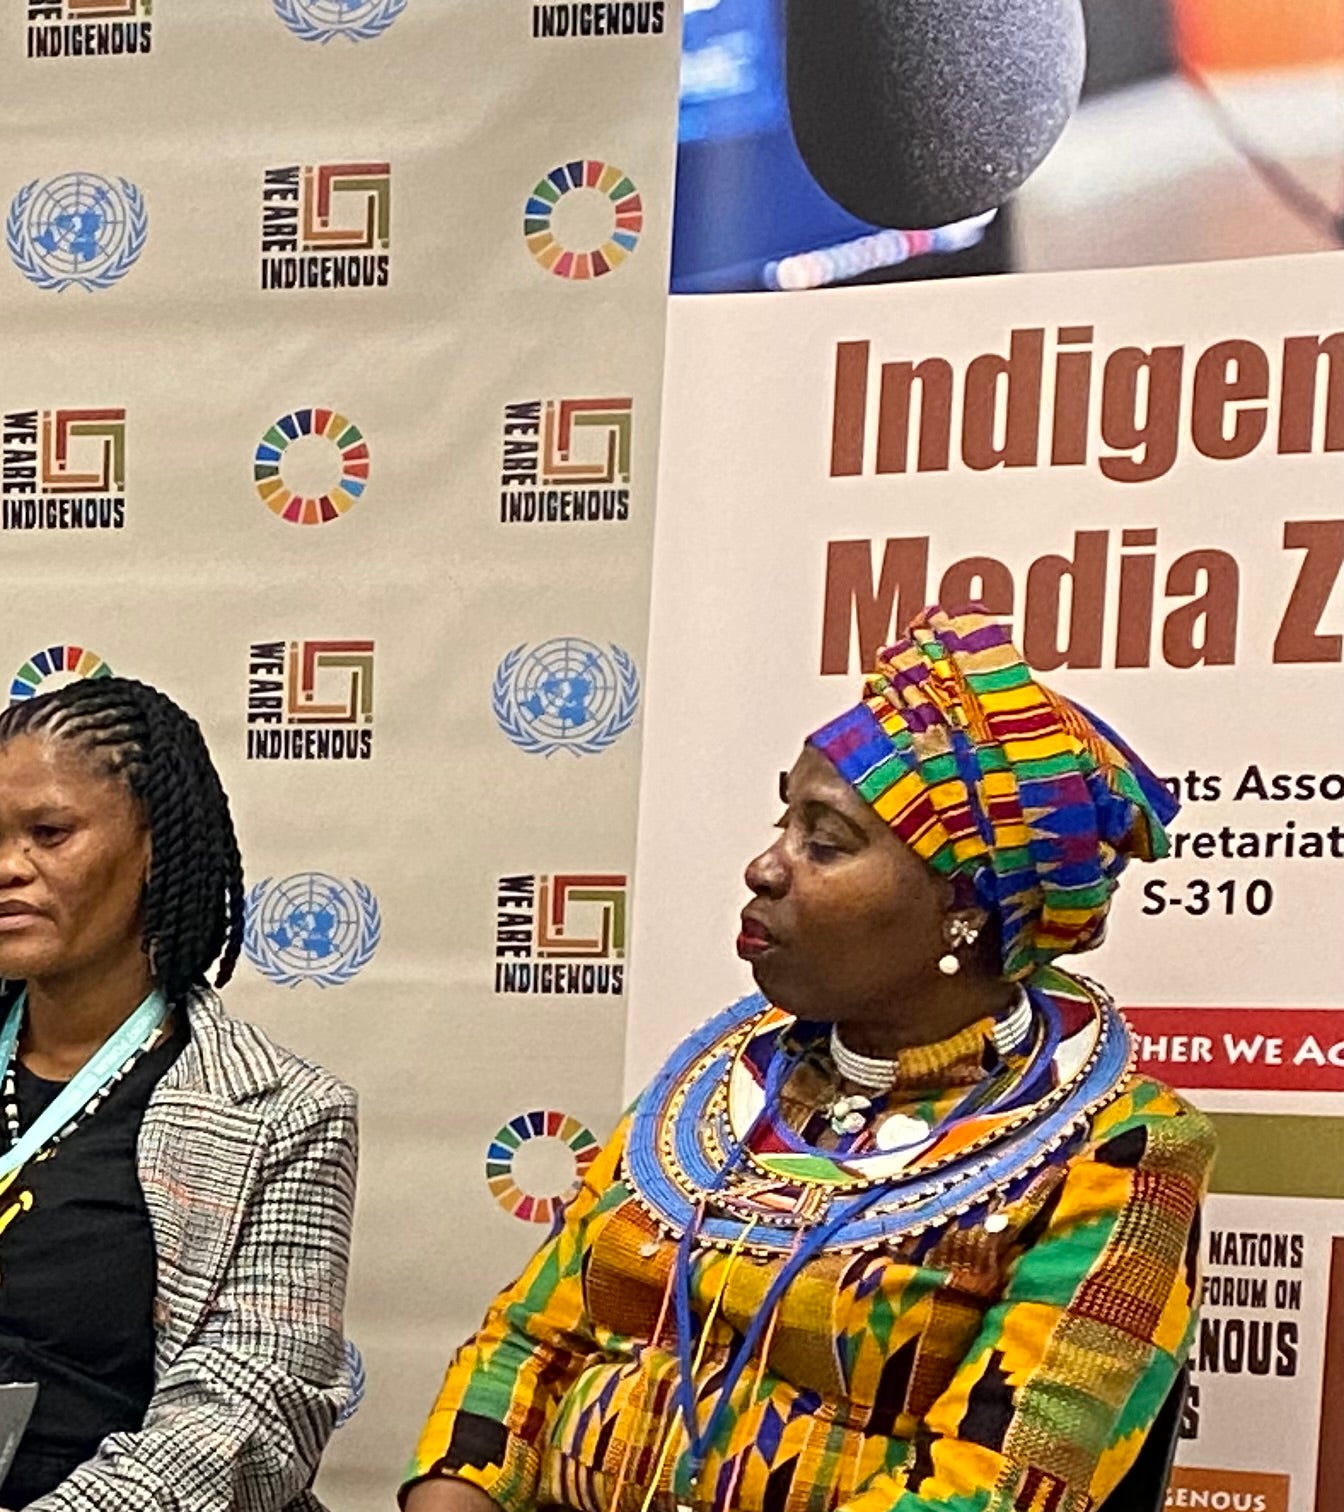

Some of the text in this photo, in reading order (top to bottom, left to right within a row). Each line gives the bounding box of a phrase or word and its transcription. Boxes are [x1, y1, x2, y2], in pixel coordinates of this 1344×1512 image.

[532, 0, 665, 38] INDIGENOUS
[27, 21, 152, 58] INDIGENOUS
[261, 255, 389, 290] INDIGENOUS
[829, 326, 1344, 482] Indigen
[2, 497, 125, 530] INDIGENOUS
[500, 489, 630, 523] INDIGENOUS
[820, 527, 1239, 675] Media
[247, 728, 373, 760] INDIGENOUS
[1141, 879, 1273, 916] S-310
[494, 962, 624, 996] INDIGENOUS
[1136, 1034, 1213, 1062] HER
[1209, 1231, 1304, 1268] NATIONS
[1201, 1276, 1302, 1310] FORUM ON
[1188, 1318, 1298, 1377] NOUS
